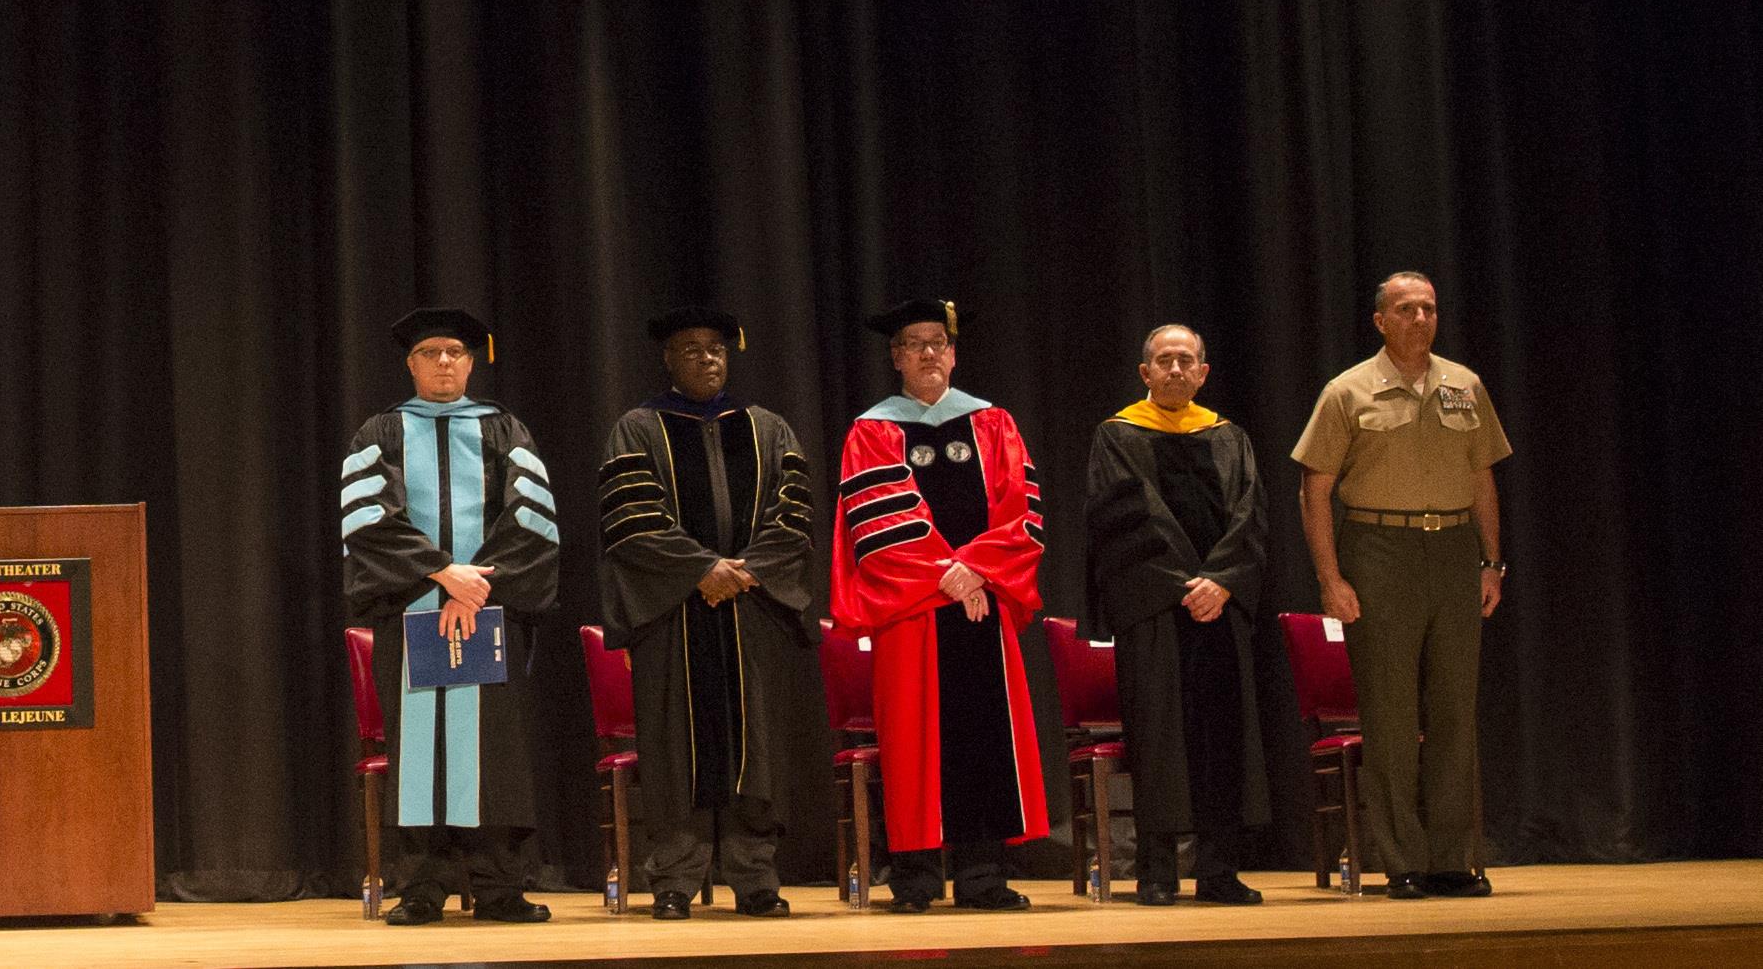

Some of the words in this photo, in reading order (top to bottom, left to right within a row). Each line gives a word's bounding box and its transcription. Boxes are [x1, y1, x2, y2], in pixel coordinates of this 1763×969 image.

[10, 602, 44, 626] STATES
[16, 659, 48, 686] CORPS
[1, 710, 66, 724] LEJEUNE
